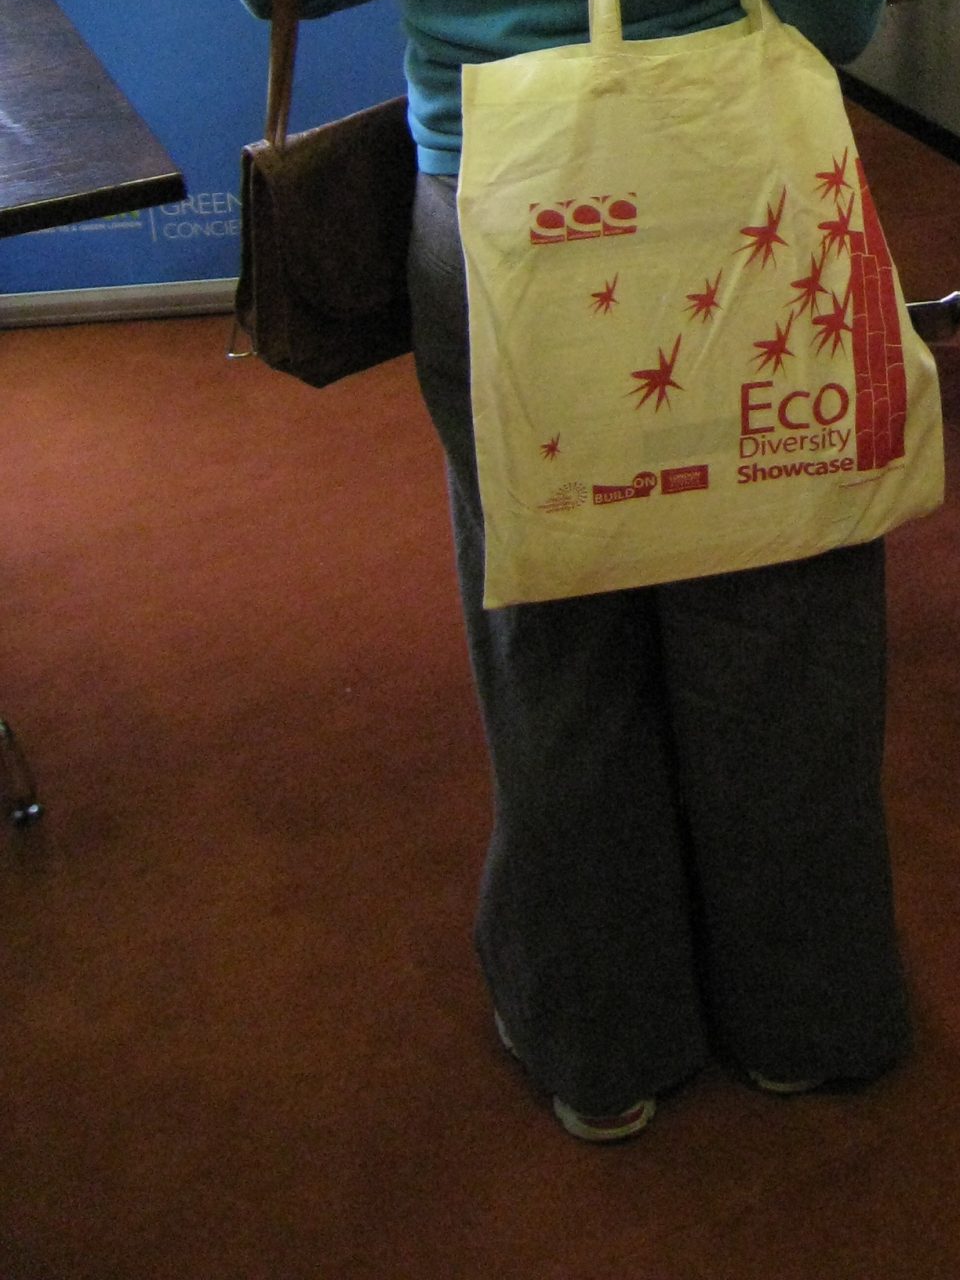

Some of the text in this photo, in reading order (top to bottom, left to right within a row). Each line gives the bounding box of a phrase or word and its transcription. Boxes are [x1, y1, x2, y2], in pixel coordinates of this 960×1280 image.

[164, 220, 241, 239] CONCIE
[741, 380, 850, 436] Eco
[739, 428, 851, 459] Diversity
[737, 457, 854, 484] Showcase
[594, 487, 636, 505] BUILD
[633, 476, 656, 490] ON
